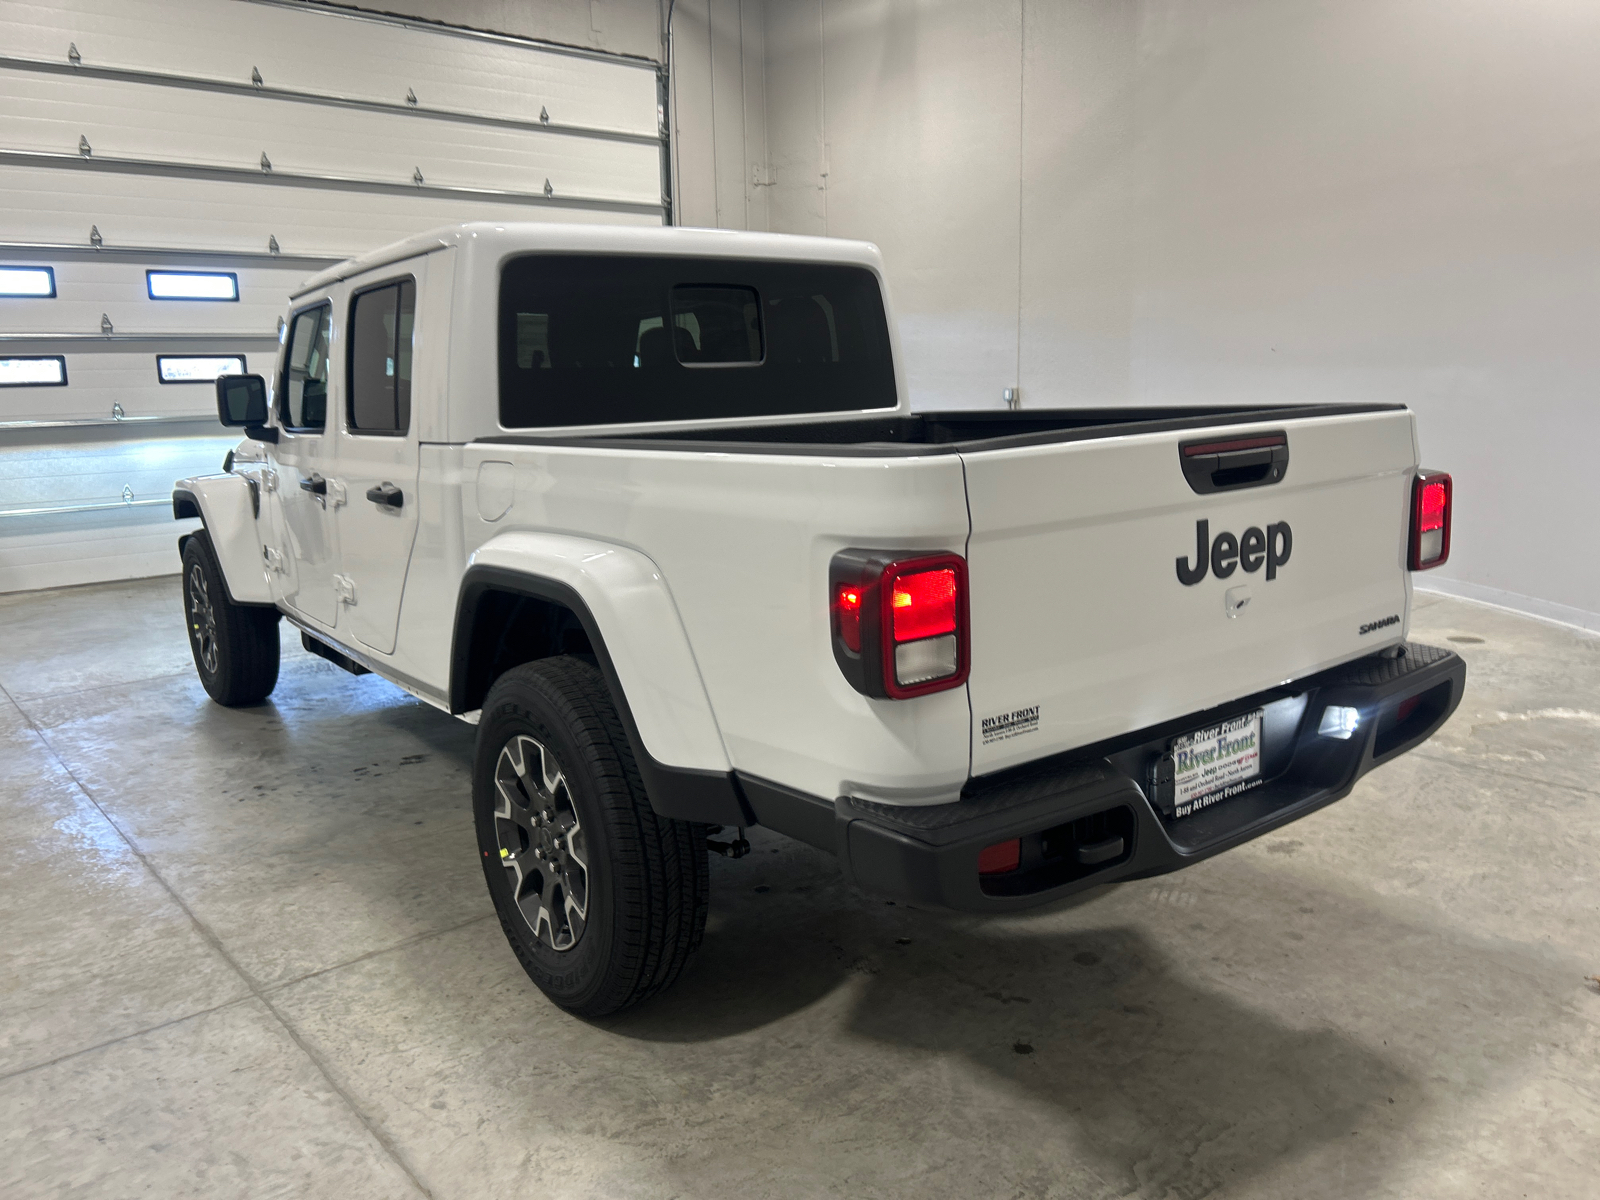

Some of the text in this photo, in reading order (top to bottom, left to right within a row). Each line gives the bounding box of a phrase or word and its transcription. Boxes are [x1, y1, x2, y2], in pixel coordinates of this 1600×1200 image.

[1176, 518, 1292, 587] Jeep
[1359, 614, 1401, 635] SAHARA
[982, 713, 1010, 728] RIVER
[1011, 706, 1039, 721] FRONT
[1194, 727, 1219, 745] River
[1221, 717, 1246, 734] Front
[1176, 746, 1216, 775] River
[1216, 730, 1256, 761] Front
[1201, 766, 1218, 778] Jeep
[1176, 803, 1192, 818] Buy
[1193, 799, 1203, 811] At
[1203, 791, 1224, 807] River
